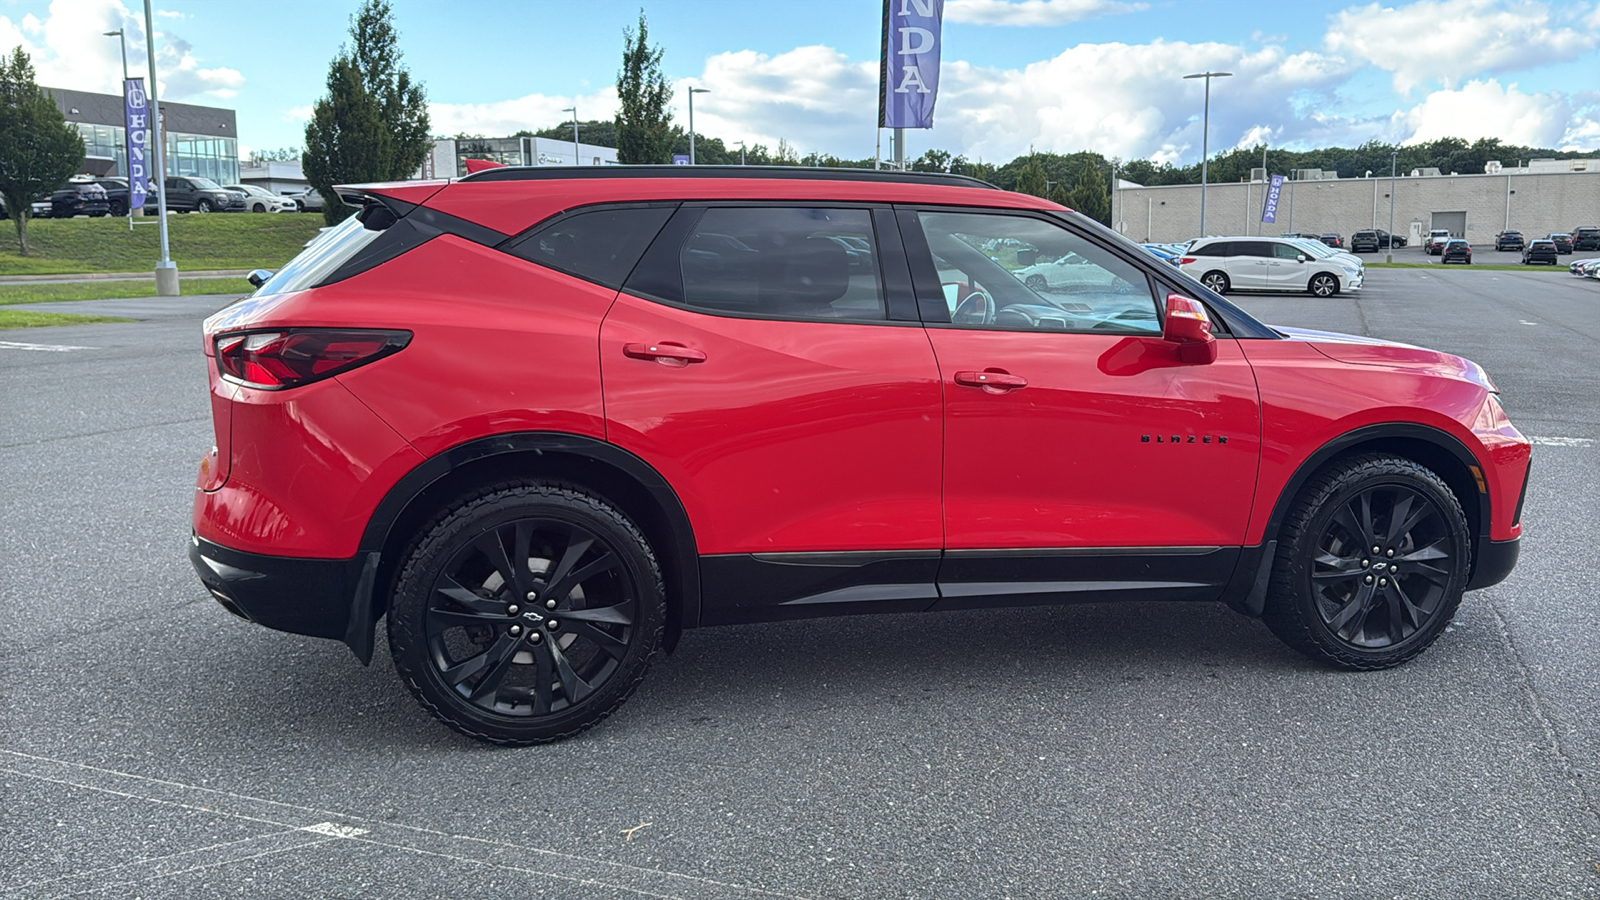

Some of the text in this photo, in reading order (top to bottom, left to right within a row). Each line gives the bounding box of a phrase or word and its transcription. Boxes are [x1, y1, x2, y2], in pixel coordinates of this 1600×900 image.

[130, 114, 147, 194] HONDA
[1265, 187, 1280, 218] HONDA
[1140, 434, 1228, 444] BLAZER
